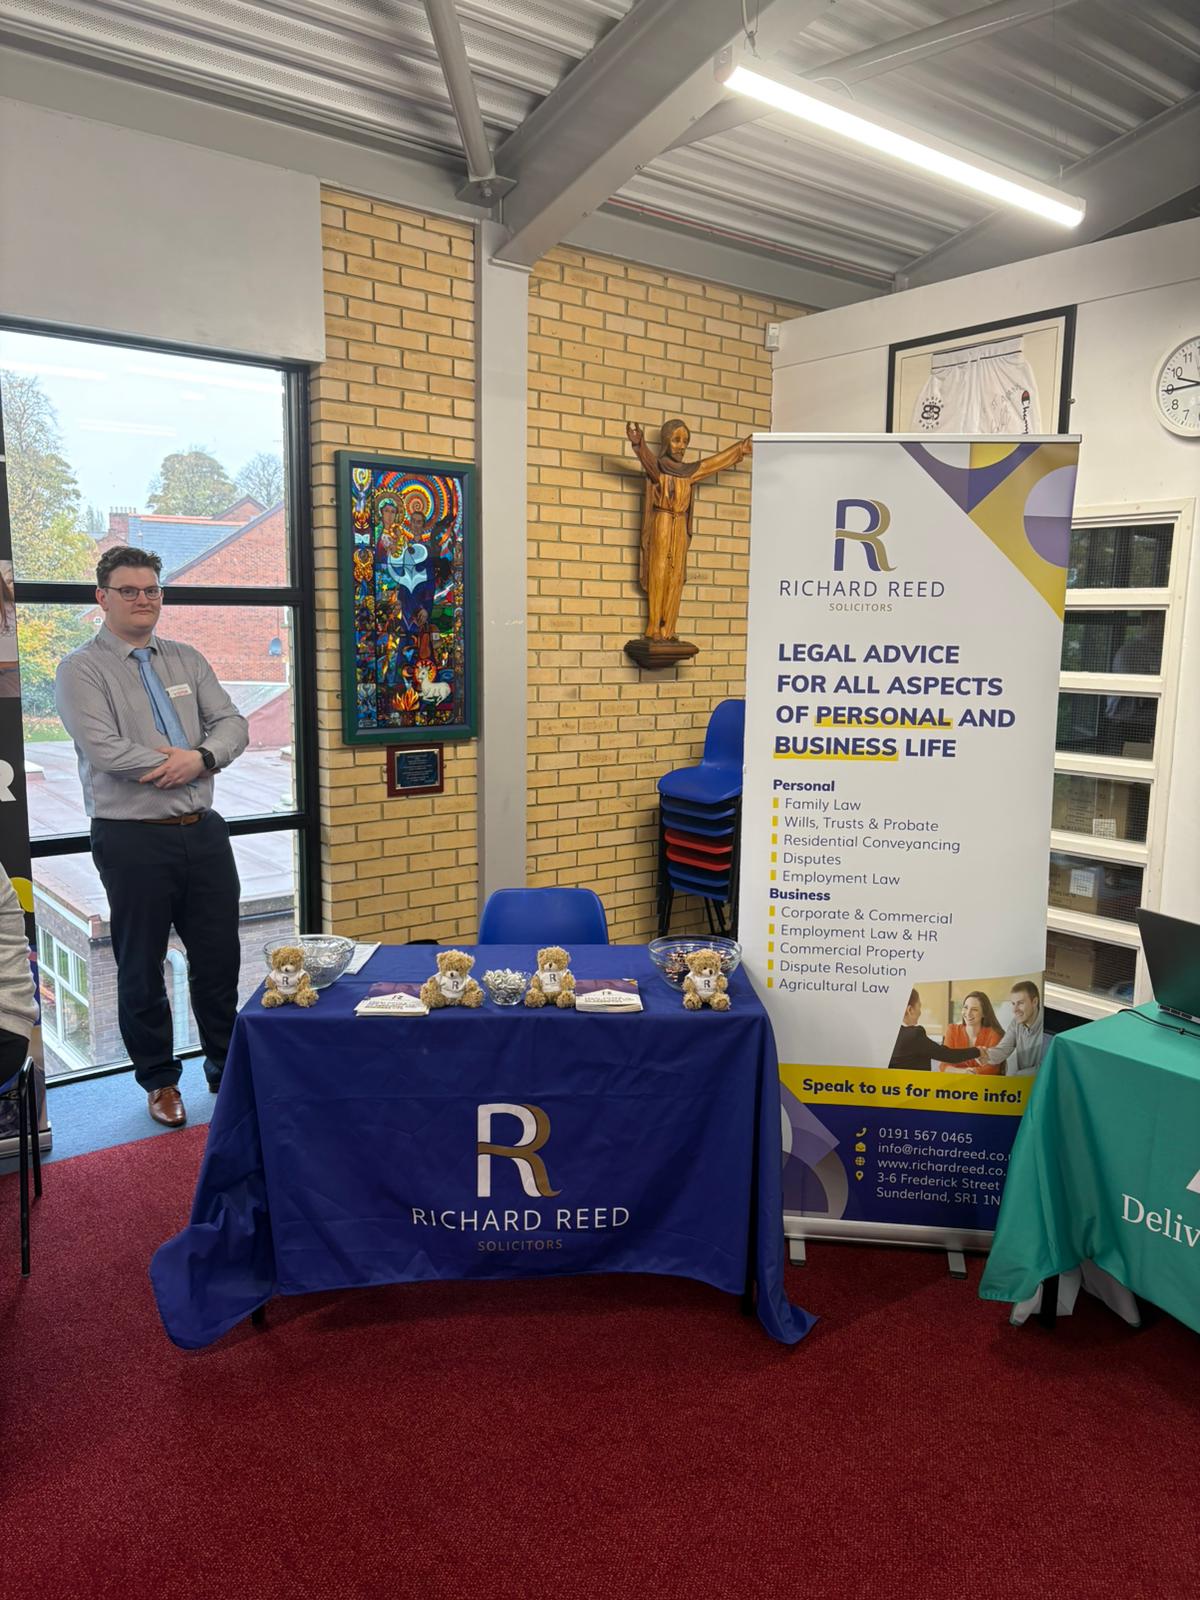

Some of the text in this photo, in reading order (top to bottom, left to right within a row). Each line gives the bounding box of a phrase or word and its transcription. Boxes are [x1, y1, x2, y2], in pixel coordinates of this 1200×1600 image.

[1183, 352, 1193, 363] 11
[1171, 366, 1183, 378] 10
[1166, 384, 1174, 395] 9
[1171, 399, 1179, 410] 8
[1183, 409, 1190, 420] 7
[834, 498, 898, 572] R
[779, 580, 945, 598] RICHARD REED
[829, 602, 893, 612] SOLICITORS
[778, 643, 960, 664] LEGAL ADVICE
[777, 674, 1003, 696] FOR ALL ASPECTS
[776, 705, 1016, 728] OF PERSONAL AND
[774, 736, 957, 758] BUSINESS LIFE
[773, 779, 835, 793] Personal
[785, 797, 861, 812] Family Law
[784, 816, 939, 832] Wills, Trusts & Probate
[784, 834, 960, 854] Residential Conveyancing
[783, 852, 842, 867] Disputes
[782, 870, 900, 886] Employment Law
[769, 888, 831, 902] Business
[781, 906, 953, 925] Corporate & Commercial
[780, 924, 938, 942] Employment Law & HR
[780, 942, 925, 962] Commercial Property
[780, 960, 907, 977] Dispute Resolution
[282, 976, 289, 986] R
[452, 980, 459, 990] R
[549, 973, 557, 982] R
[703, 979, 711, 988] R
[779, 978, 890, 994] Agricultural Law
[802, 1078, 1022, 1104] Speak to us for more info!
[879, 1127, 973, 1144] 0191 567 0465
[477, 1103, 562, 1198] R
[877, 1171, 1000, 1191] 3-6 Frederick Street
[876, 1186, 950, 1204] Sunderland,
[954, 1191, 978, 1205] SR1
[412, 1207, 630, 1232] RICHARD REED
[478, 1239, 563, 1252] SOLICITORS
